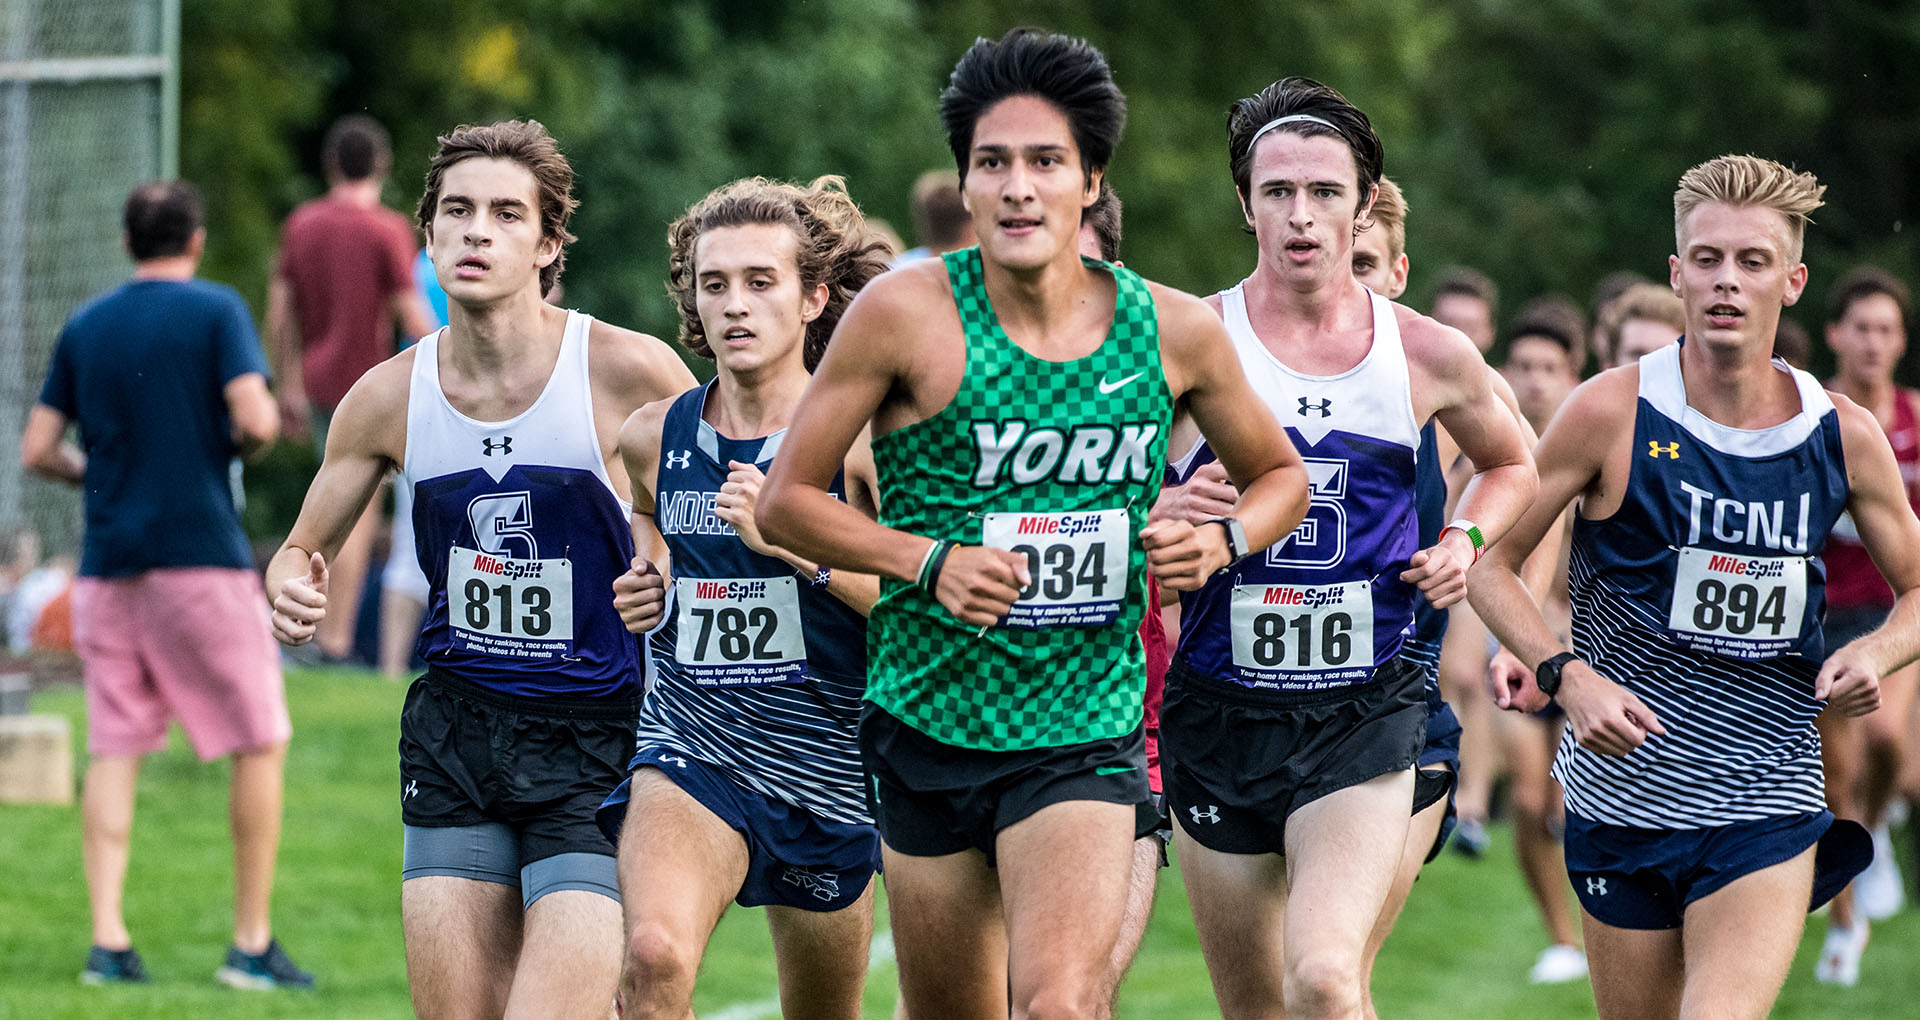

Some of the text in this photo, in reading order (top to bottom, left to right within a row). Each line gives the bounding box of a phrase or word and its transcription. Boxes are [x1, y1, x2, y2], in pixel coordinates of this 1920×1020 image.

[969, 418, 1160, 490] YORK
[467, 490, 538, 560] S
[1018, 514, 1102, 537] MileSplit
[1680, 480, 1810, 554] TCNJ
[474, 554, 543, 580] MileSplit
[1708, 555, 1784, 580] MileSplit
[696, 581, 766, 602] MileSplit
[1263, 586, 1344, 608] MileSplit
[464, 578, 552, 636] 813
[1692, 579, 1787, 635] 894
[456, 629, 468, 639] Your
[468, 633, 483, 643] home
[485, 637, 494, 645] for
[494, 639, 524, 649] rankings,
[542, 642, 567, 650] results,
[691, 608, 782, 662] 782
[1252, 612, 1352, 666] 816
[466, 642, 486, 653] photos,
[488, 647, 508, 655] videos
[517, 649, 529, 657] live
[726, 667, 756, 675] rankings,
[775, 663, 801, 673] results,
[764, 674, 787, 683] events
[1240, 669, 1256, 678] Your
[1257, 672, 1276, 680] home
[1290, 673, 1322, 682] rankings,
[1341, 670, 1367, 678] results,
[1254, 680, 1280, 689] photos,
